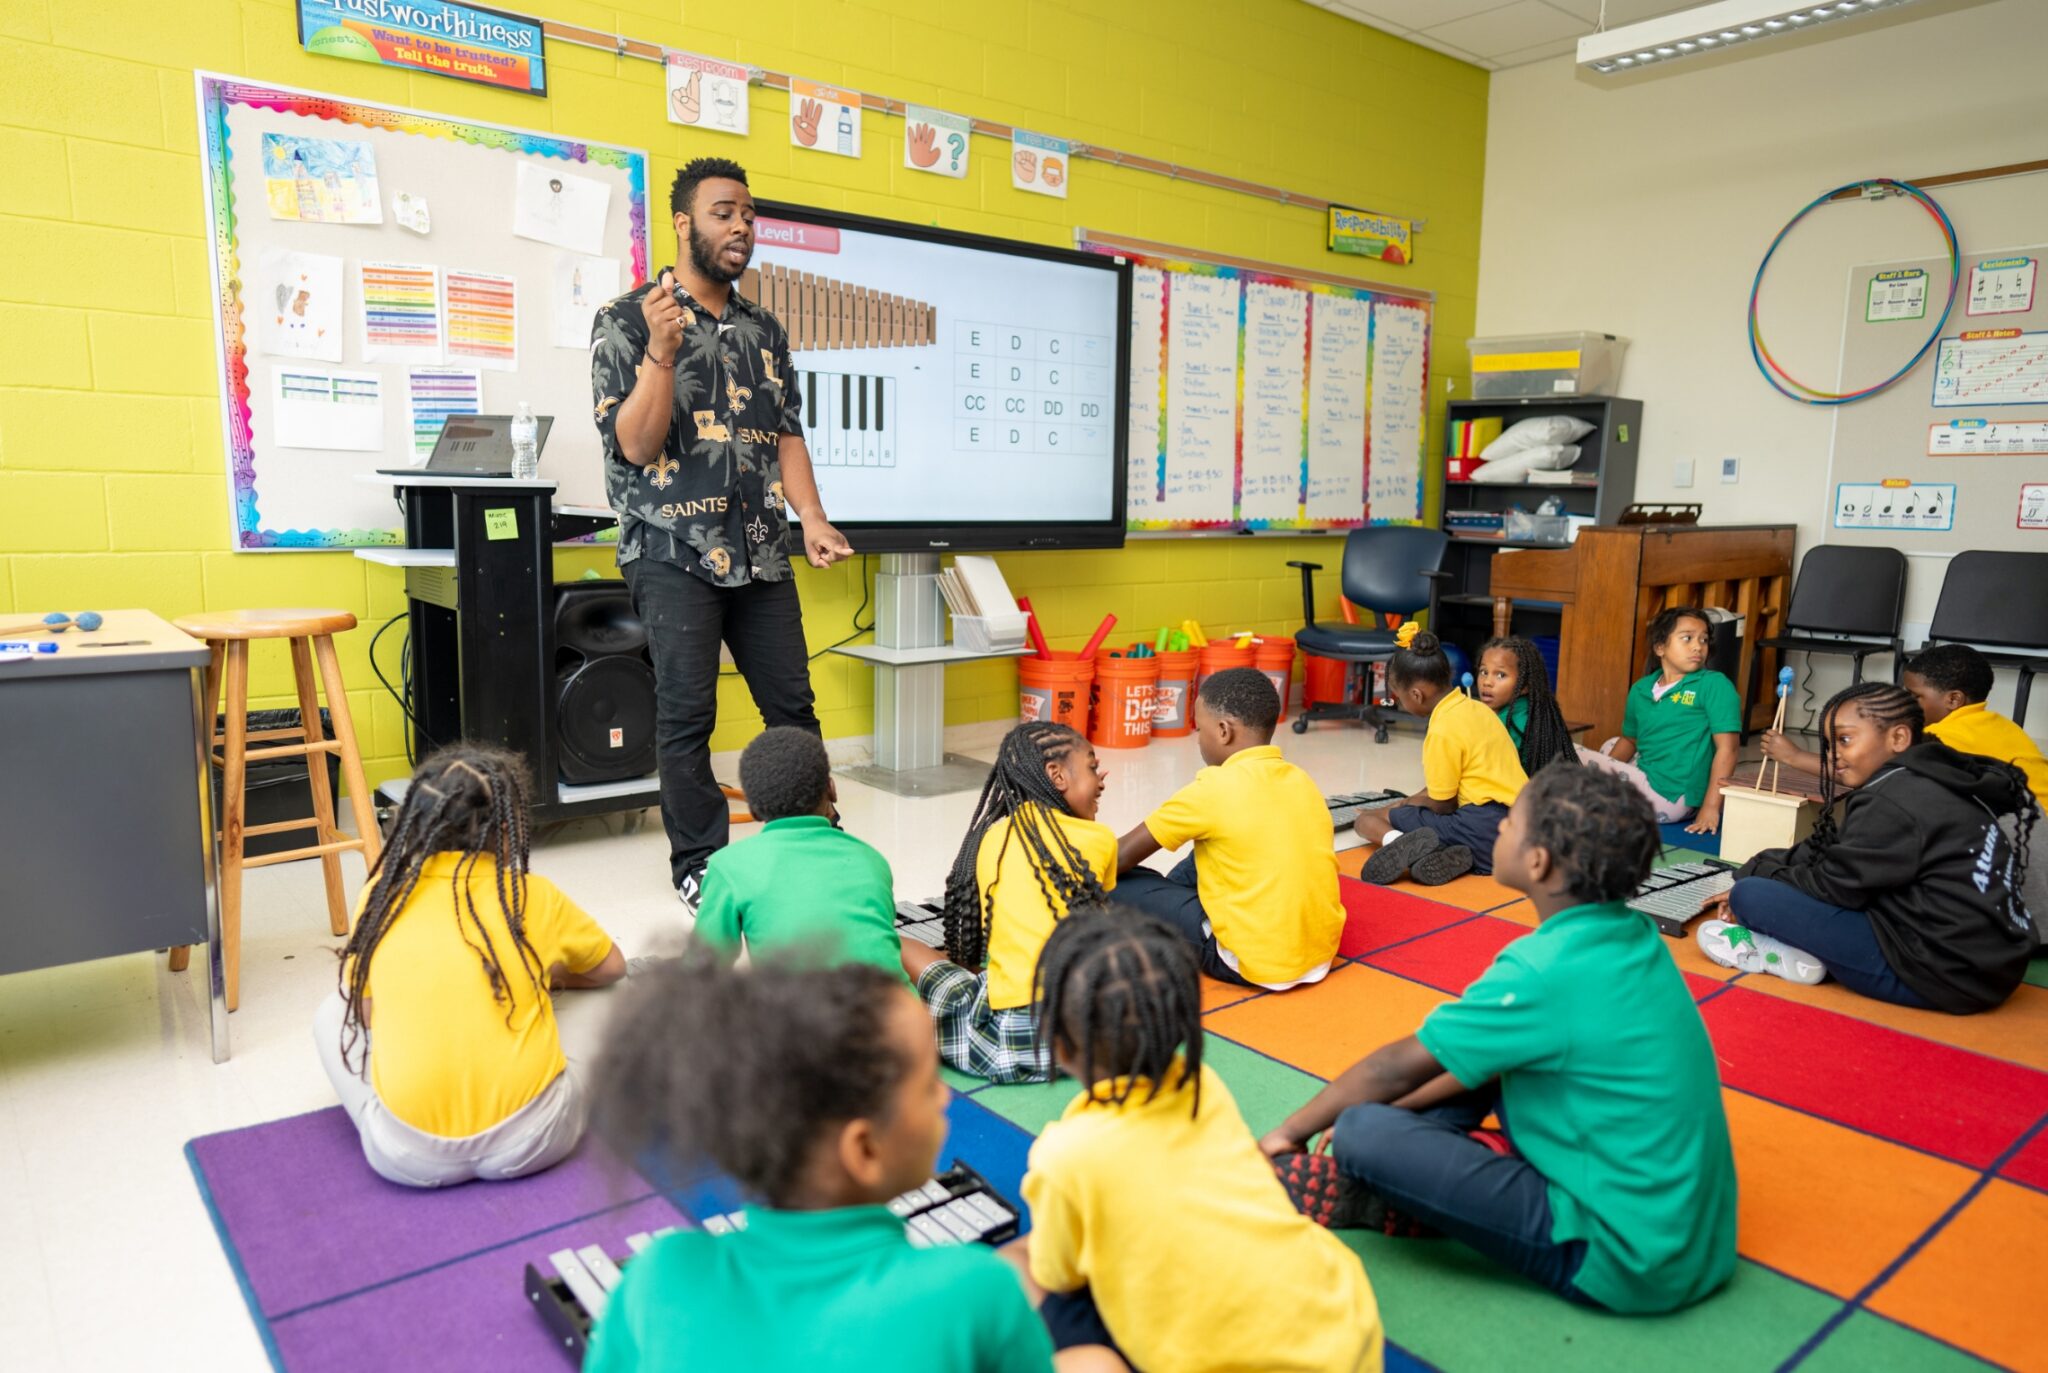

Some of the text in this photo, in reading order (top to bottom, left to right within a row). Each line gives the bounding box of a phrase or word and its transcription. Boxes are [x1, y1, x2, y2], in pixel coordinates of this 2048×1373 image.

[314, 0, 532, 48] rustworthiness
[372, 29, 517, 68] Want to be trusted?
[394, 47, 498, 78] Tell the truth.
[757, 222, 806, 243] Level 1
[971, 331, 1059, 354] E D C
[971, 363, 1059, 384] E D C
[964, 395, 1099, 417] CC CC DD DD
[970, 427, 1058, 445] E D C
[817, 448, 822, 456] E
[851, 449, 857, 457] G
[884, 450, 890, 458] B
[661, 496, 728, 518] SAINTS
[1125, 698, 1153, 721] DO
[1123, 721, 1151, 736] THIS
